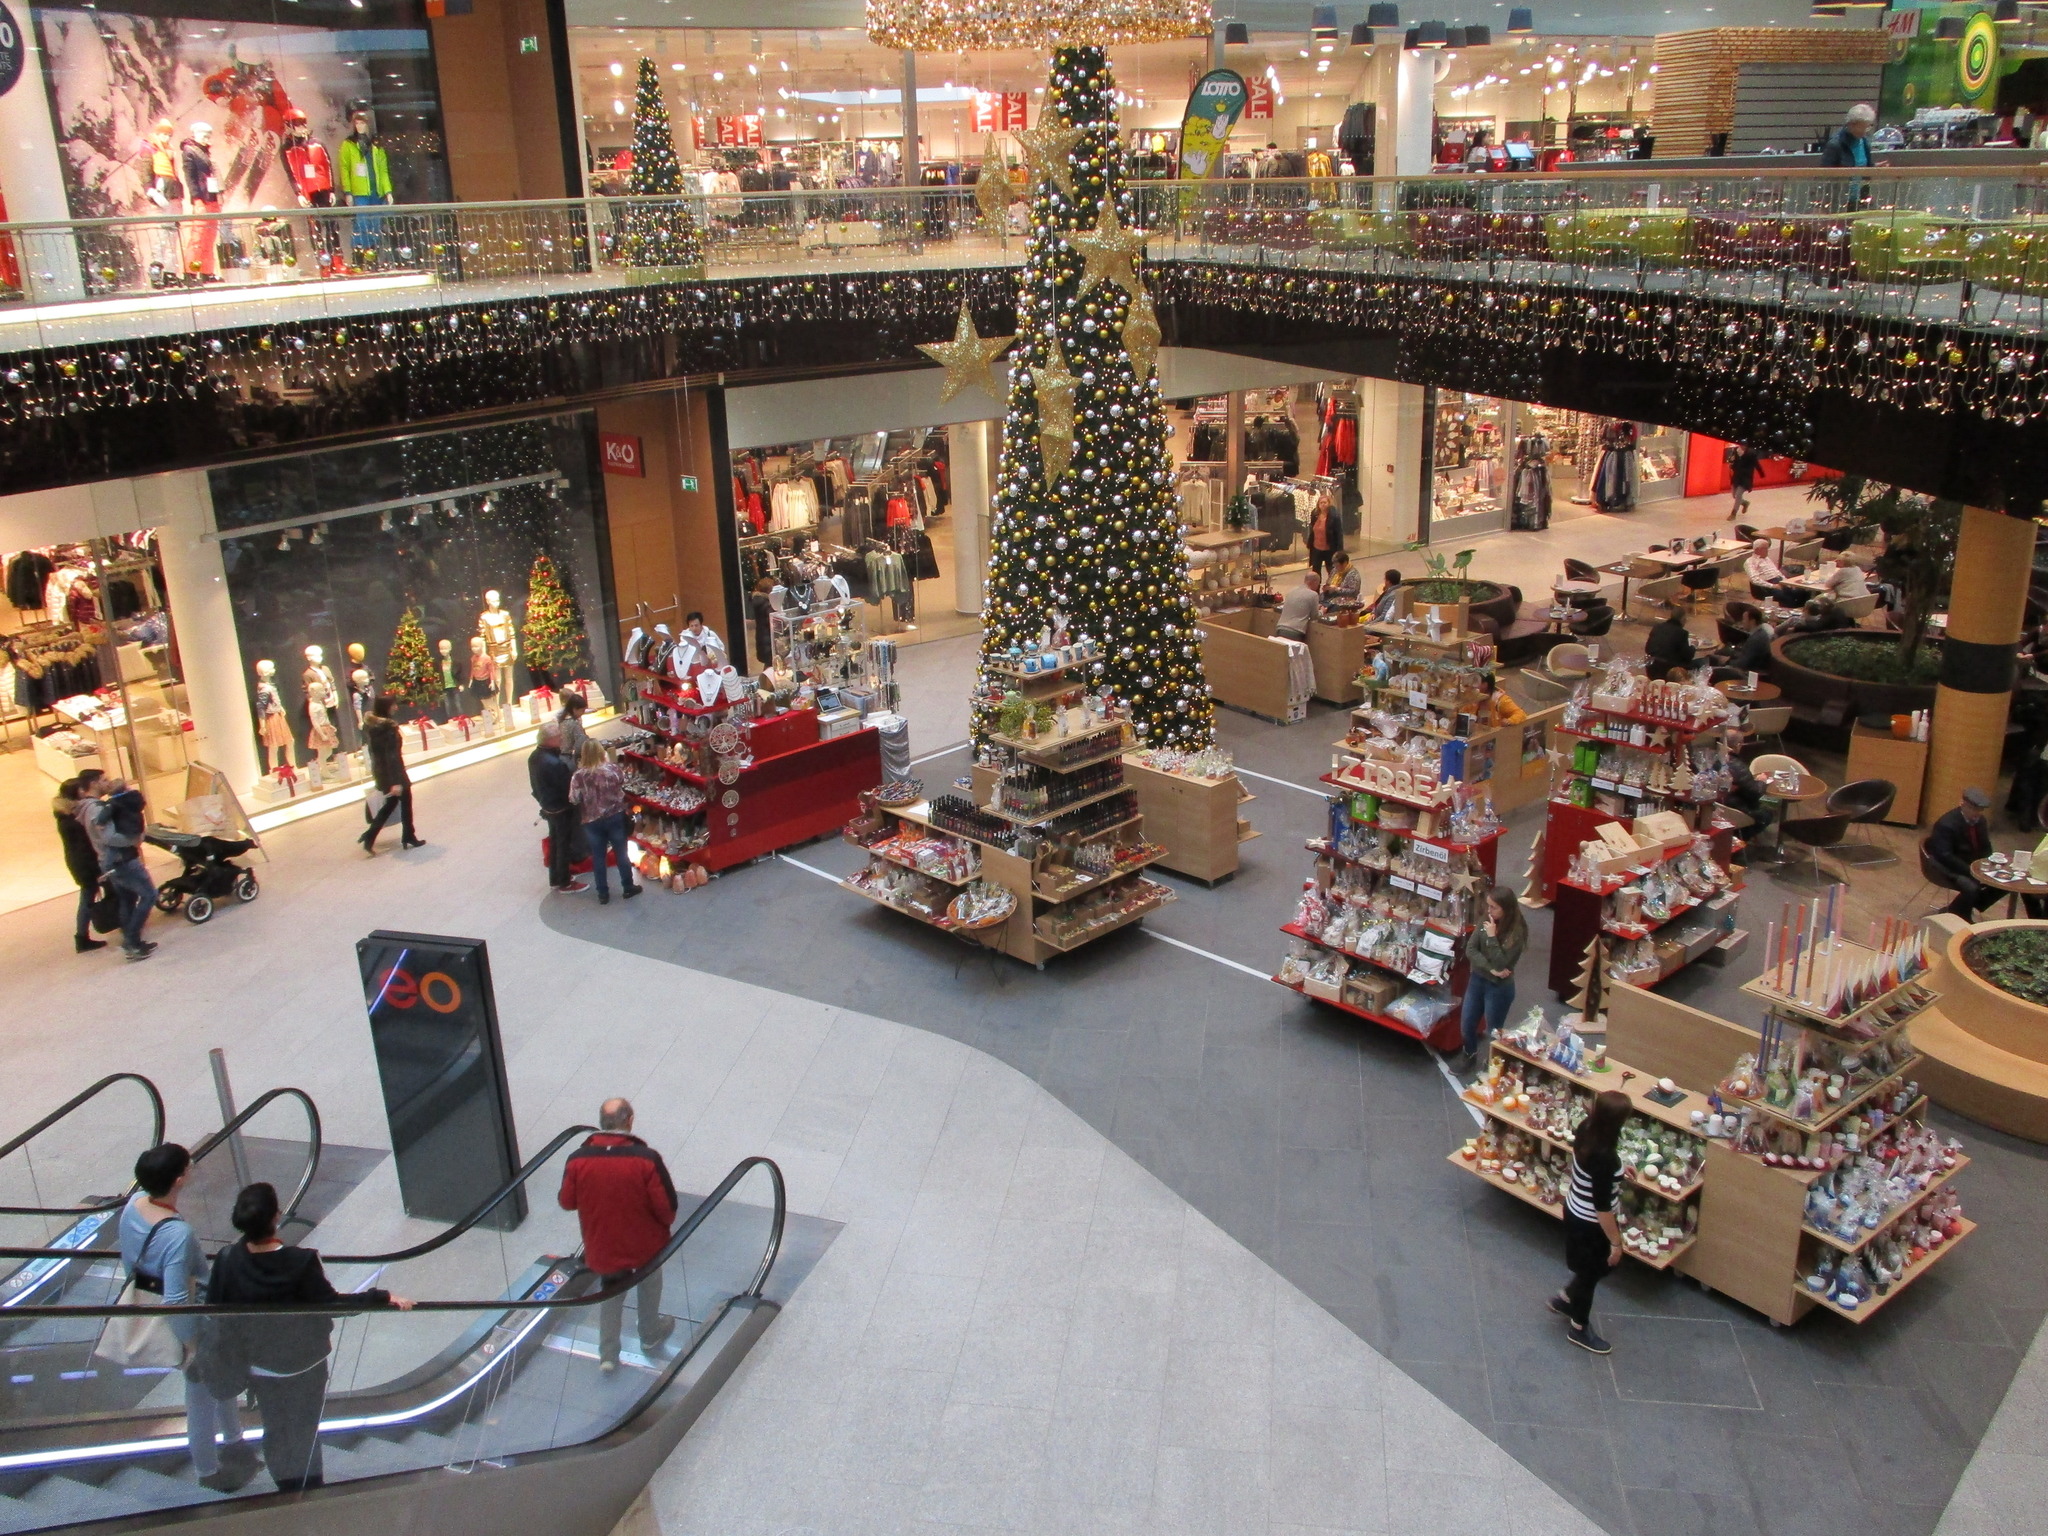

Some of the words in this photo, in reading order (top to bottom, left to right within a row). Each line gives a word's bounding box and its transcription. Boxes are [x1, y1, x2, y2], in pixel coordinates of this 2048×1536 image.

[1201, 81, 1240, 96] LOTTO
[1251, 76, 1267, 119] SALE
[976, 92, 992, 132] SALE
[1007, 92, 1022, 131] SALE
[606, 441, 634, 463] K&O
[1337, 755, 1432, 806] ZIRBE
[1415, 844, 1447, 860] Zirbenöl
